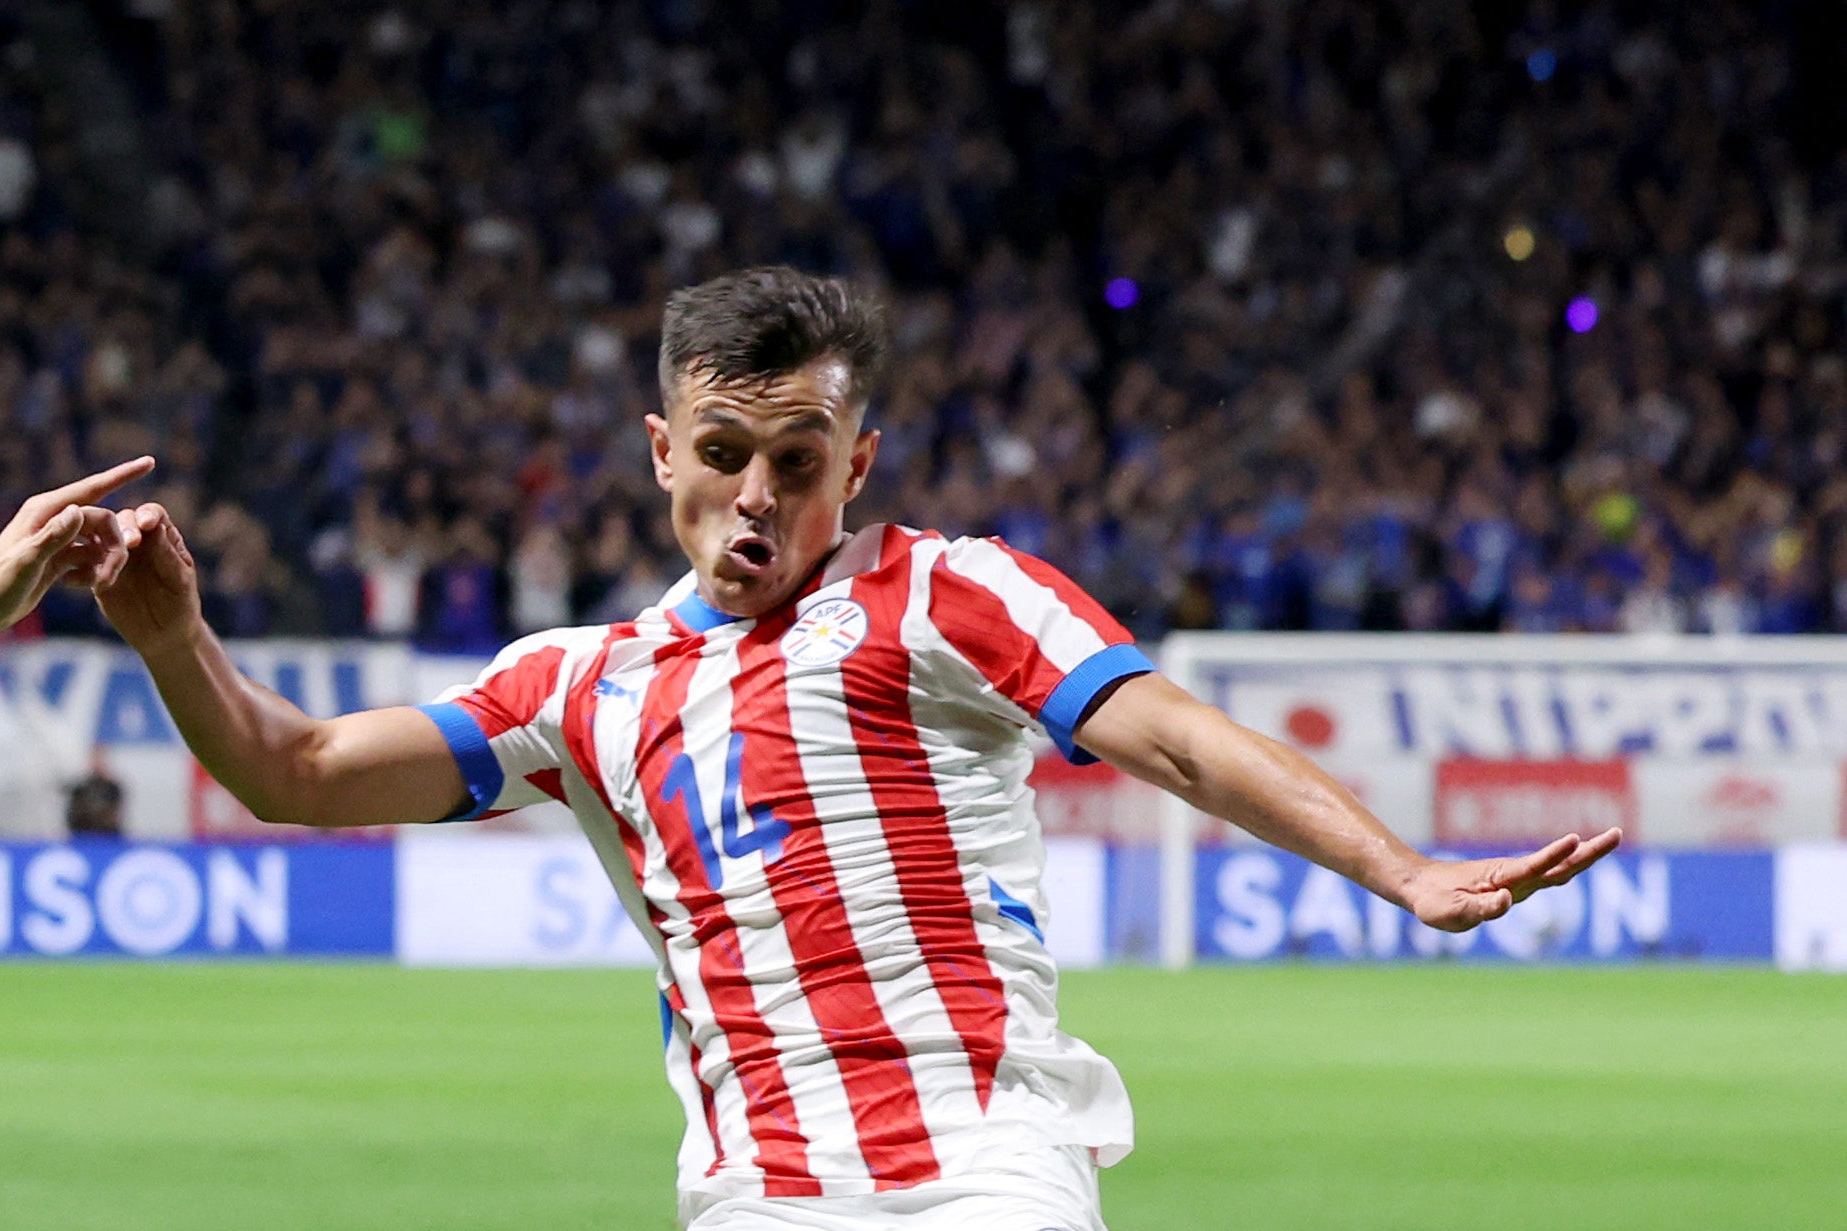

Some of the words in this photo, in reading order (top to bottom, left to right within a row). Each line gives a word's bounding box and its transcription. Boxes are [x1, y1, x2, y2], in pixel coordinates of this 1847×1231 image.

[1394, 670, 1847, 754] NIPPO
[661, 731, 792, 891] 14
[1214, 848, 1671, 959] SAION
